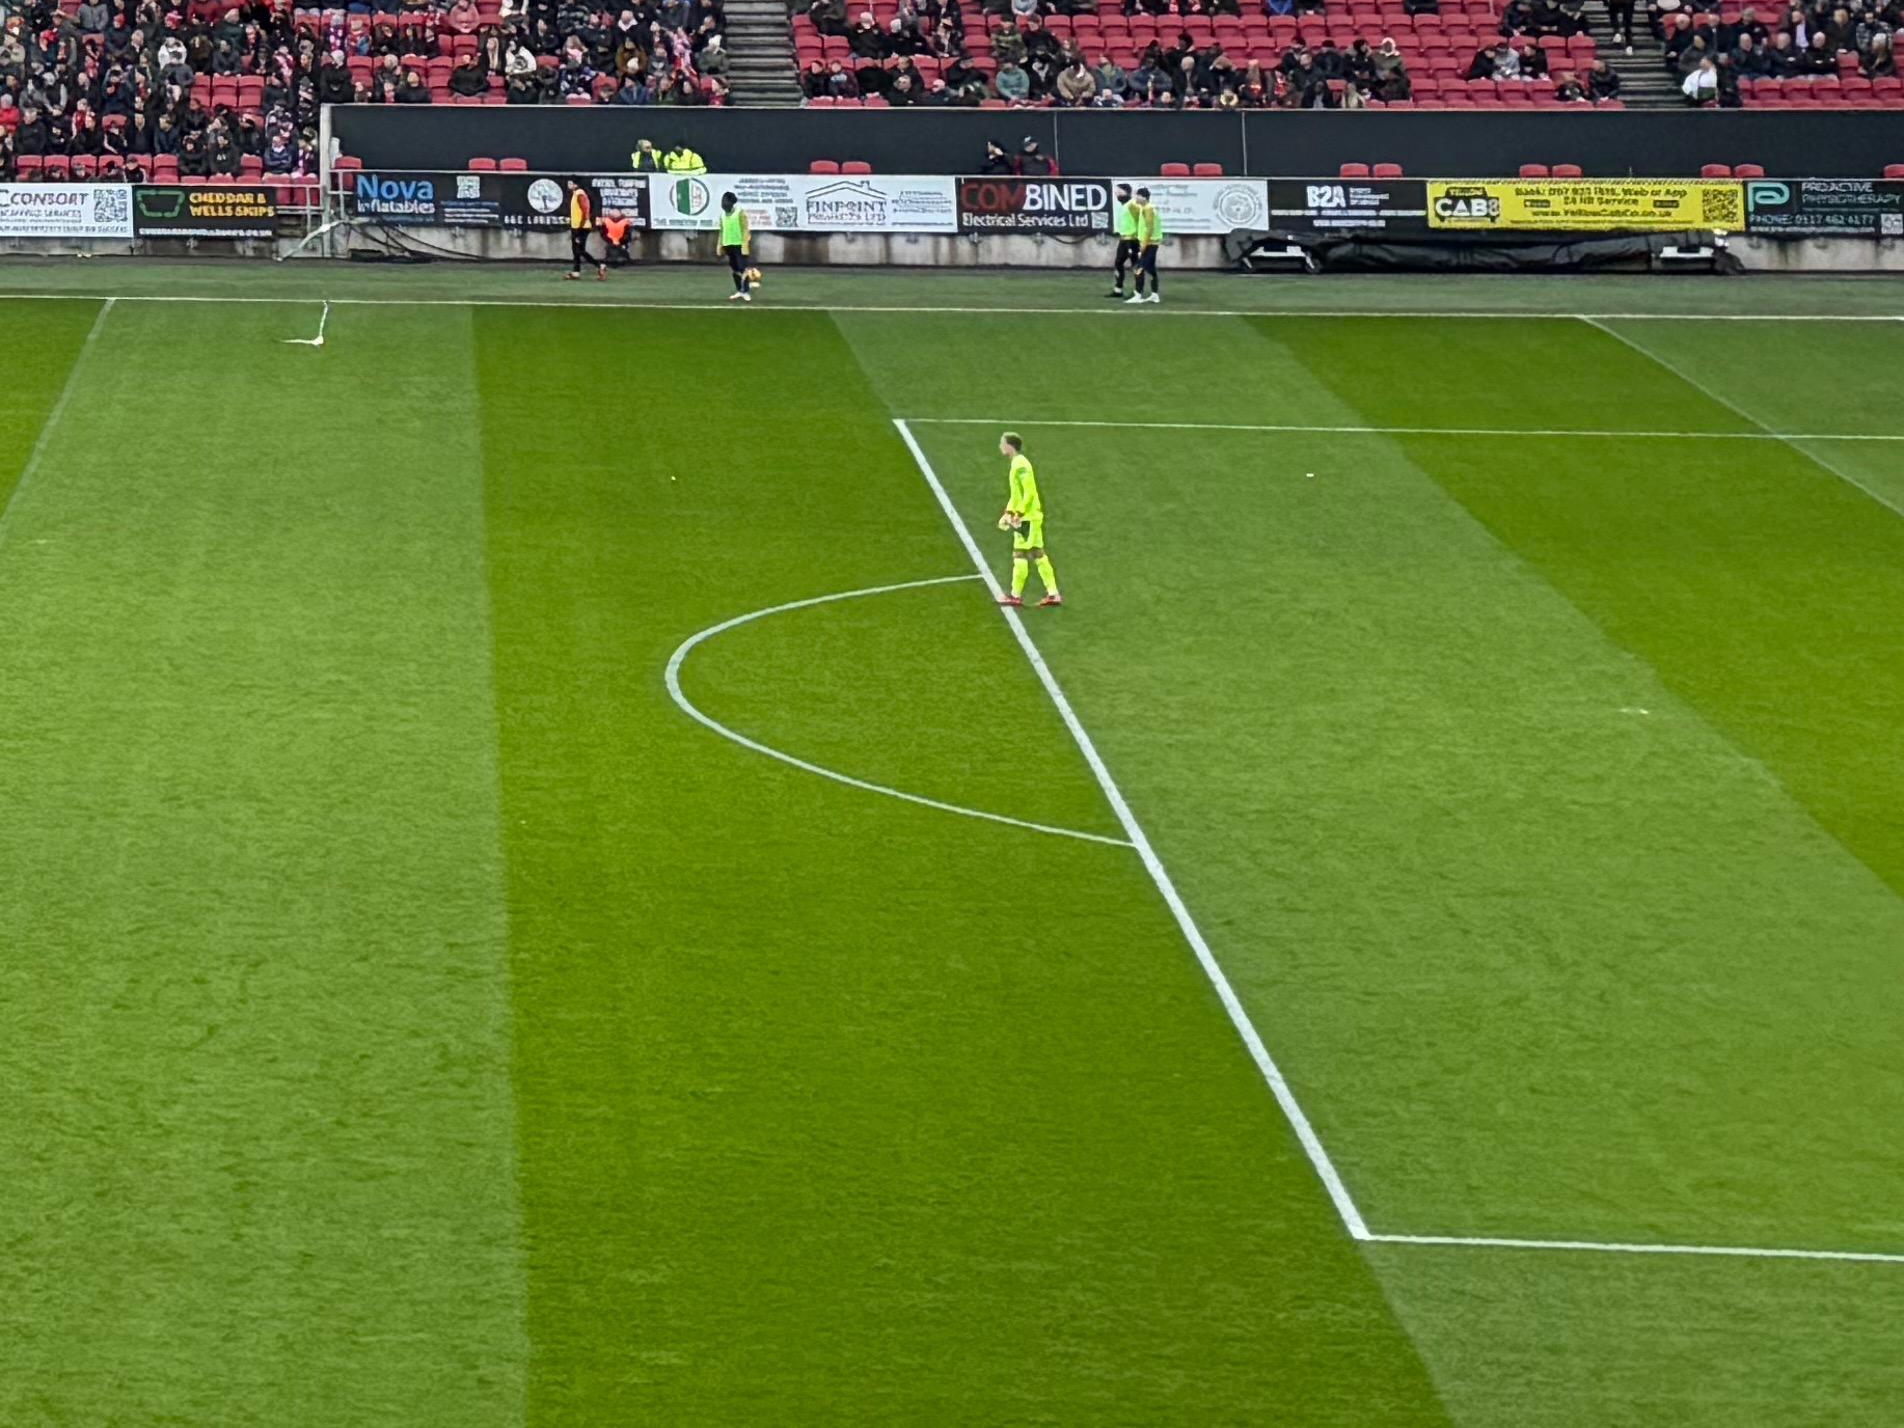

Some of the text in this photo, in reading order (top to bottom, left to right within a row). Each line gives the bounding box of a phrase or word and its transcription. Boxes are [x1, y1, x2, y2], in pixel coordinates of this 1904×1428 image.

[357, 174, 434, 200] Nova
[1801, 182, 1874, 192] PROACTIVE
[189, 192, 267, 204] CHEDDAR &
[961, 183, 1107, 211] COMBINED
[1306, 186, 1346, 208] B2A
[190, 205, 276, 217] WELLS SKIPS
[357, 200, 435, 214] Inflatables
[962, 213, 1089, 227] Electrical Services Ltd
